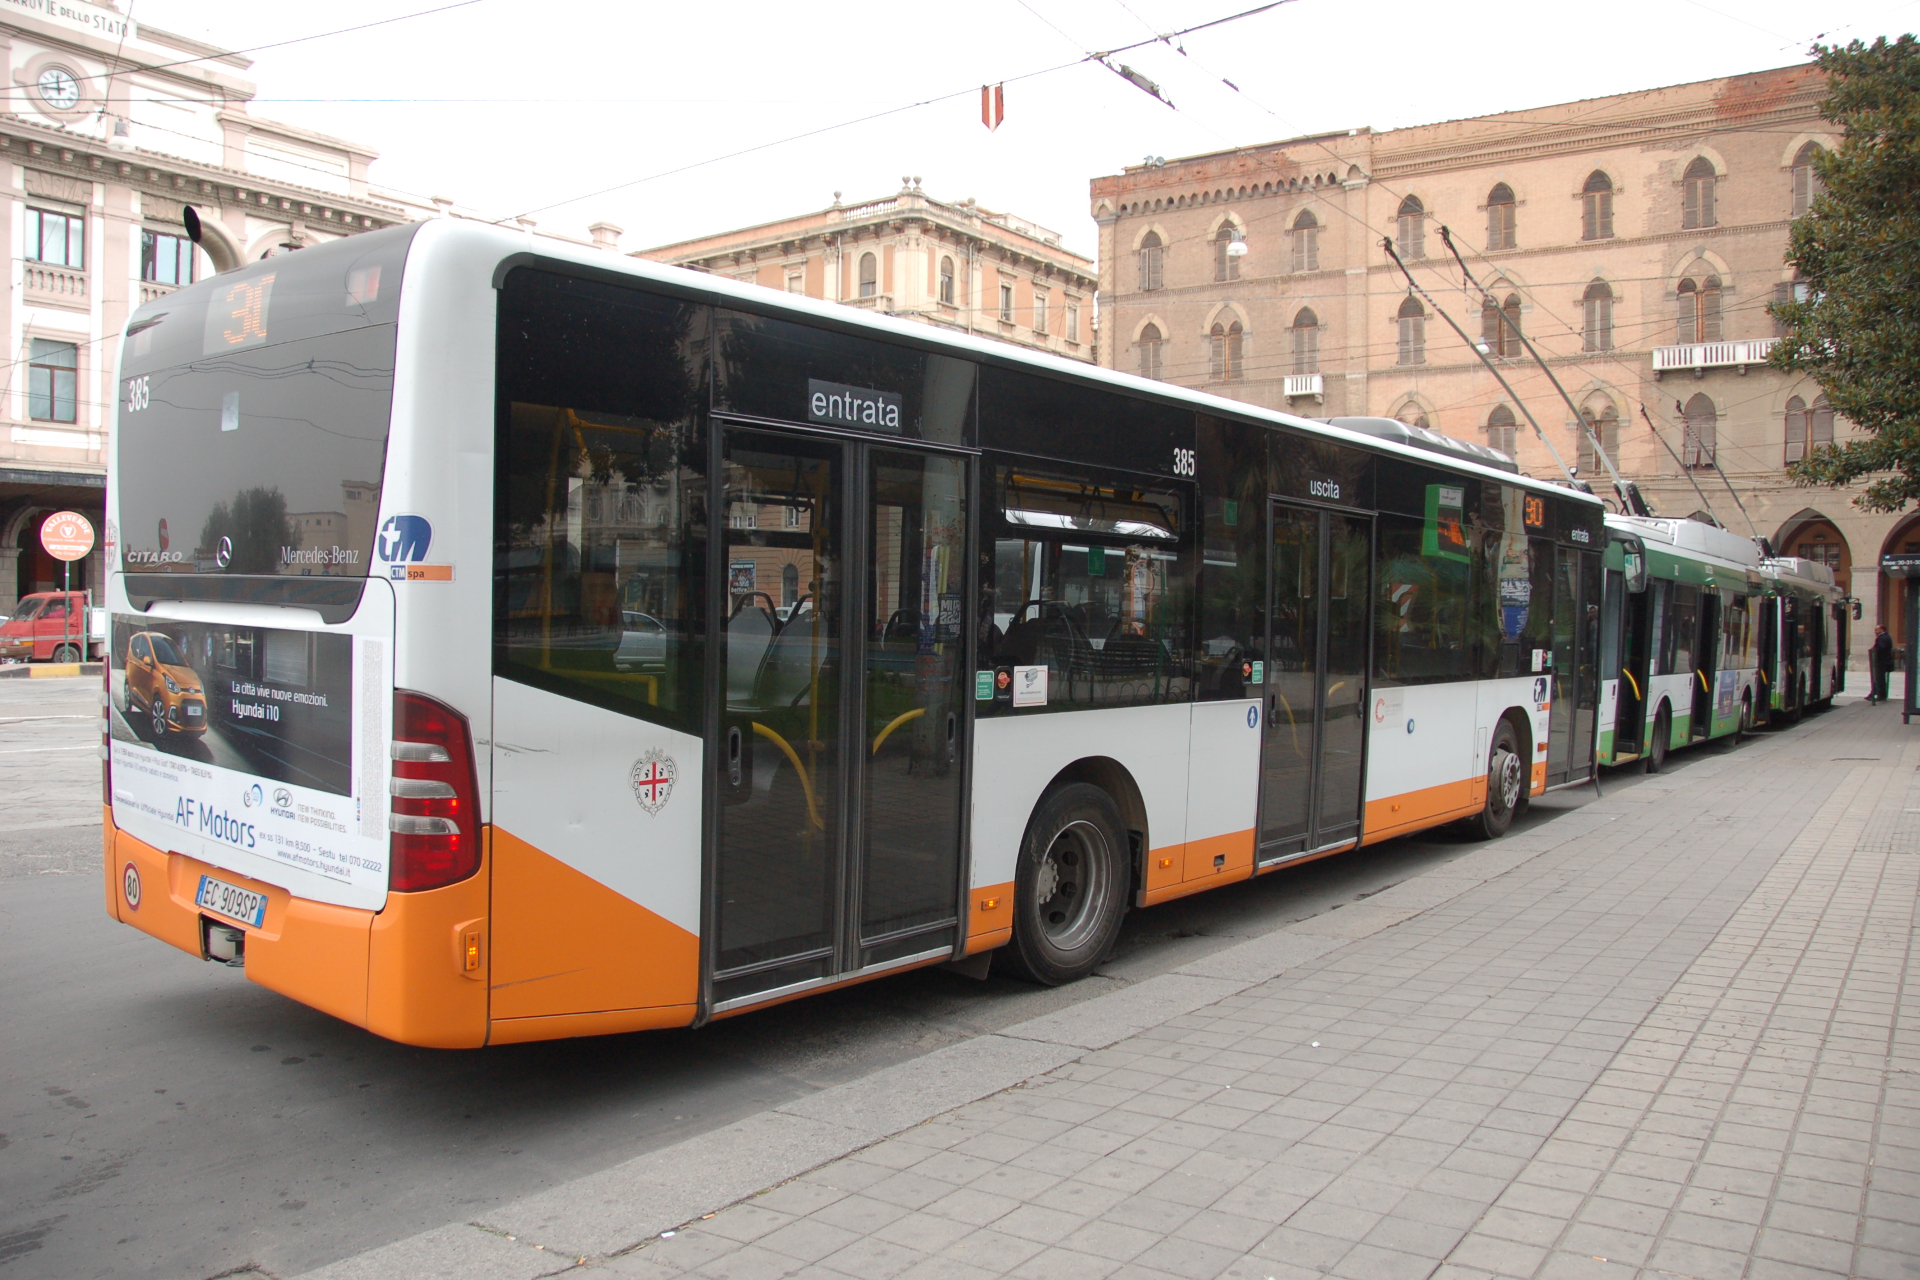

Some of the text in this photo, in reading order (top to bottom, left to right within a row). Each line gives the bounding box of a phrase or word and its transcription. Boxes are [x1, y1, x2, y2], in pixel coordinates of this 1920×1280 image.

[60, 6, 90, 23] DELLO
[93, 15, 128, 37] STATO
[128, 375, 150, 412] 385
[811, 391, 900, 427] entrata
[1173, 447, 1196, 477] 385
[1310, 478, 1340, 499] uscita
[1525, 496, 1543, 526] 30
[45, 514, 91, 535] VALLEVERDE
[1571, 528, 1589, 543] entrata
[127, 551, 182, 564] CITARO
[280, 545, 359, 564] Mercedes-Benz
[391, 567, 425, 580] CTM spa
[232, 681, 328, 707] La città vive nuove emozioni.
[232, 699, 280, 722] Hyundai i10
[175, 796, 255, 848] AF Motors
[270, 806, 296, 820] HYUNDAI
[259, 831, 267, 840] ex
[267, 834, 273, 842] ss
[275, 834, 284, 845] 131
[285, 837, 294, 848] km
[295, 840, 311, 853] 8,500
[318, 846, 336, 860] Sestu
[339, 852, 348, 863] tel
[349, 855, 361, 867] 070
[362, 858, 382, 873] 22222
[277, 849, 351, 877] www.afmotors.hyundai.it
[127, 875, 137, 899] 80
[203, 880, 257, 920] EC 909SP
